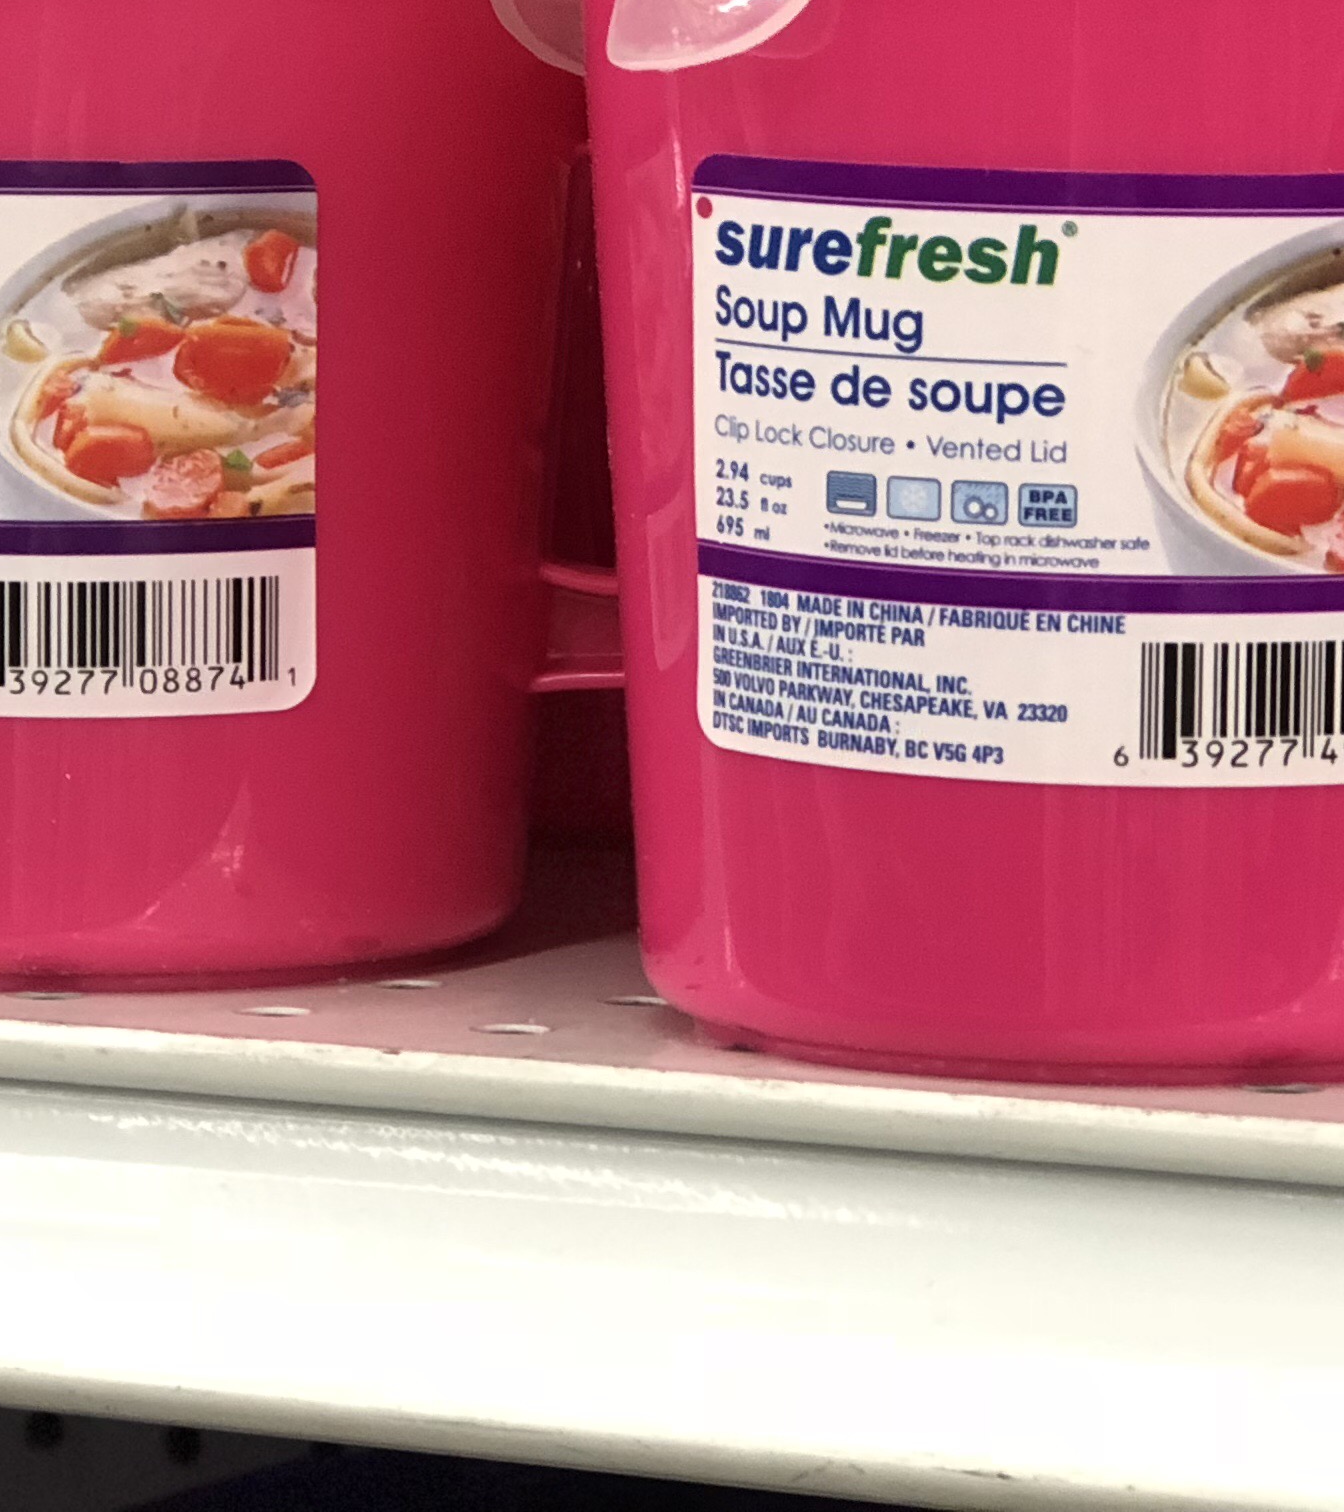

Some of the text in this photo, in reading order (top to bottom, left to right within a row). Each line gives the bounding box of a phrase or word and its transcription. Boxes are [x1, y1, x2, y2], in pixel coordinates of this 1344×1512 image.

[715, 284, 924, 354] Soup Mug
[715, 350, 1066, 424] Tasse de soupe
[714, 414, 1067, 463] Clip Lock Closure Vented Lid
[716, 458, 792, 490] 2.94 cups
[716, 485, 749, 510] 23.5
[772, 502, 787, 515] oz
[1029, 489, 1067, 504] BPA
[716, 514, 770, 541] 695 ml
[1024, 506, 1072, 522] FREE
[914, 527, 960, 543] Freezer
[976, 531, 1001, 548] Top
[1004, 534, 1035, 547] rack
[1039, 534, 1117, 550] dishwasher
[1120, 536, 1151, 551] safe
[884, 544, 898, 559] lid
[901, 546, 945, 562] before
[948, 549, 1001, 568] heating
[1004, 553, 1016, 566] in
[1019, 554, 1100, 569] microwave
[713, 601, 778, 630] IMPORTED
[782, 613, 801, 634] BY
[891, 626, 925, 647] PAR
[797, 593, 842, 617] MADE
[847, 599, 864, 619] IN
[869, 602, 923, 625] CHINA
[939, 606, 1030, 631] FABRIQUÉ
[1036, 613, 1061, 632] EN
[1067, 614, 1126, 634] CHINE
[713, 624, 725, 642] IN
[777, 635, 806, 656] AUX
[9, 669, 119, 695] 39277
[139, 666, 246, 694] 08874
[287, 667, 297, 687] 1
[713, 646, 793, 676] GREENBRIER
[937, 675, 972, 695] INC.
[713, 688, 726, 708] IN
[729, 692, 784, 719] CANADA
[797, 705, 817, 724] AU
[822, 708, 891, 733] CANADA
[734, 671, 775, 696] VOLVO
[779, 680, 855, 709] PARKWAY,
[860, 690, 978, 720] CHESAPEAKE,
[983, 700, 1008, 720] VA
[1017, 703, 1068, 723] 23320
[713, 711, 1004, 765] DTSC IMPORTS BURNABY, BC V5G 4P3
[1113, 745, 1129, 767] 6
[1181, 739, 1300, 768] 39277
